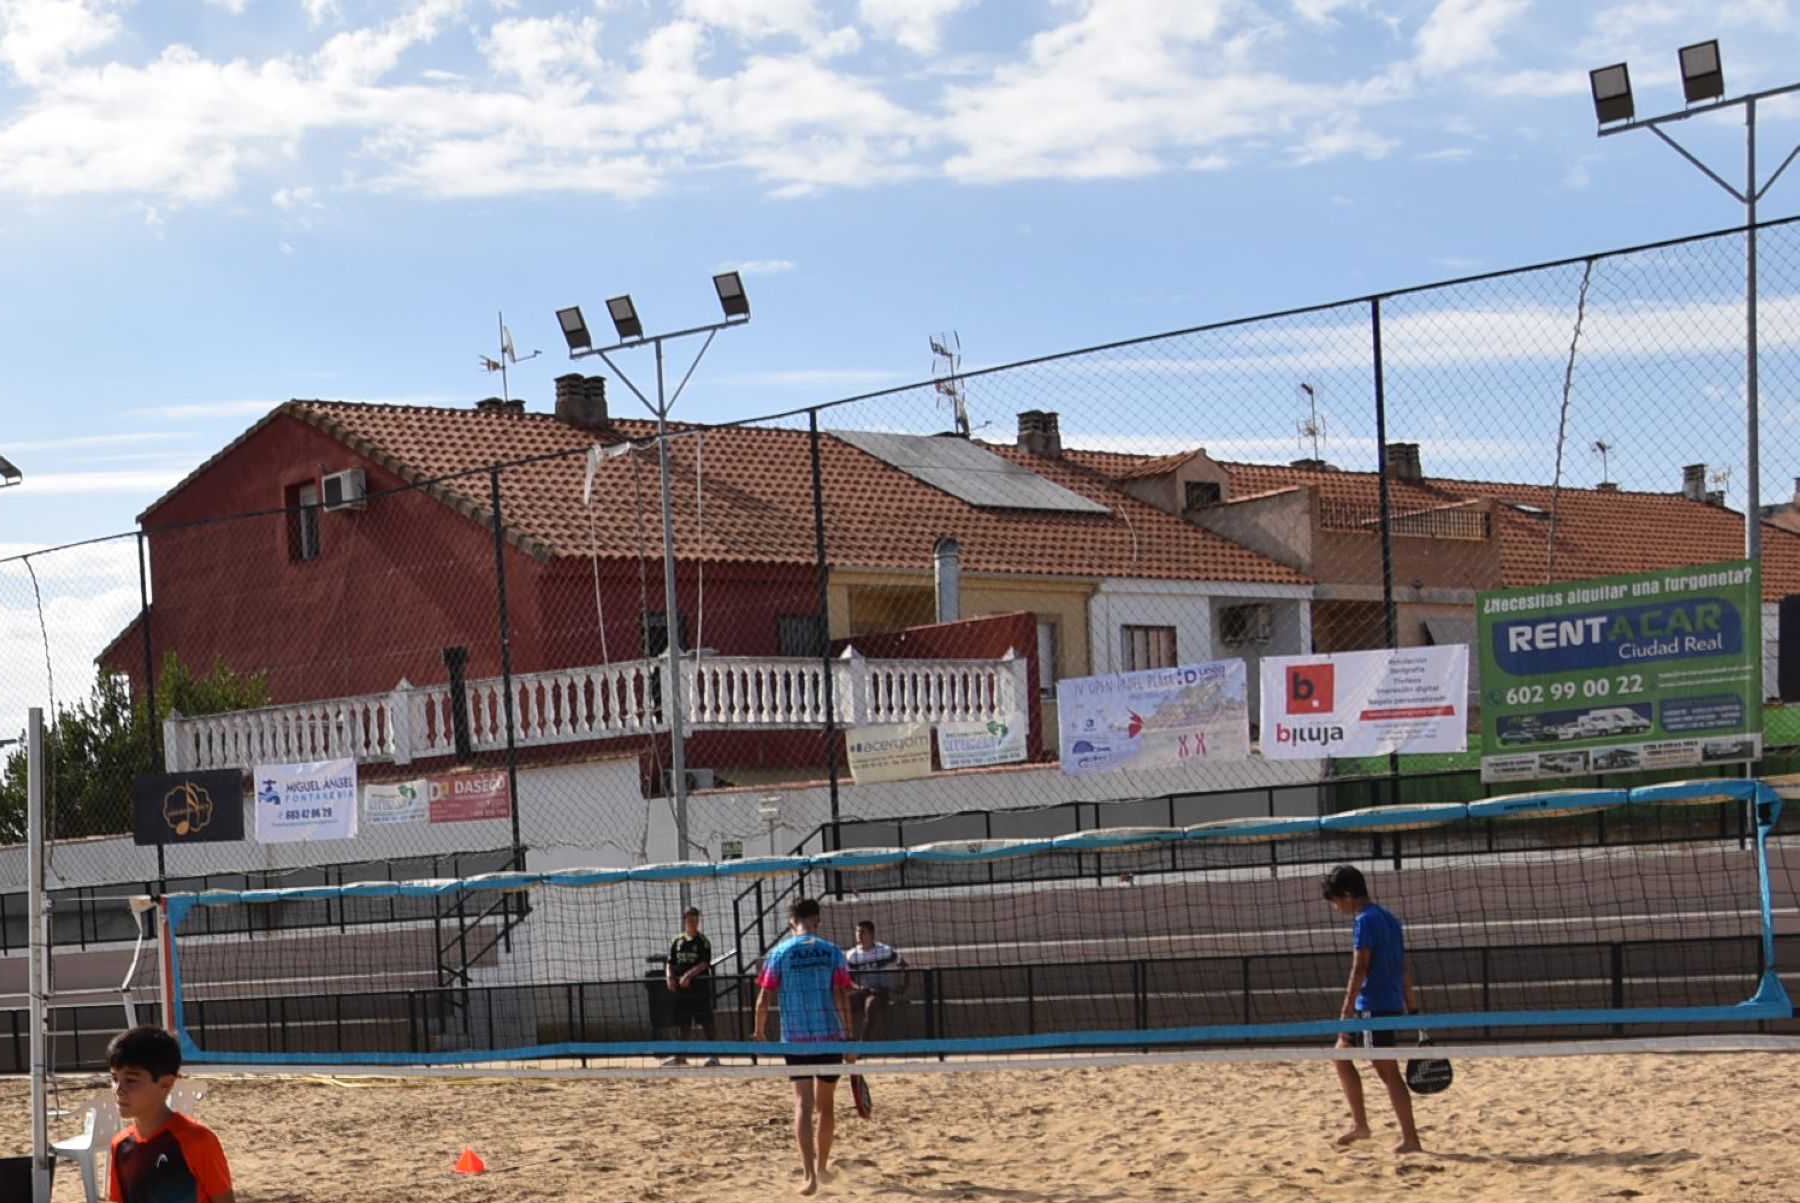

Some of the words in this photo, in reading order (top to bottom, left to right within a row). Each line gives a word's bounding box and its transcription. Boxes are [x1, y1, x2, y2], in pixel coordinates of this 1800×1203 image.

[1484, 591, 1563, 614] ¿Necesitas
[1568, 584, 1628, 606] alquilar
[1632, 579, 1660, 597] una
[1664, 567, 1753, 592] furgoneta?
[1508, 617, 1608, 652] RENT
[1640, 603, 1722, 637] CAR
[1619, 640, 1679, 660] Ciudad
[1684, 632, 1723, 653] Real
[1506, 684, 1544, 705] 602
[1550, 681, 1576, 701] 99
[1583, 678, 1610, 699] 00
[1617, 674, 1643, 694] 22
[286, 780, 320, 793] MIGUEL
